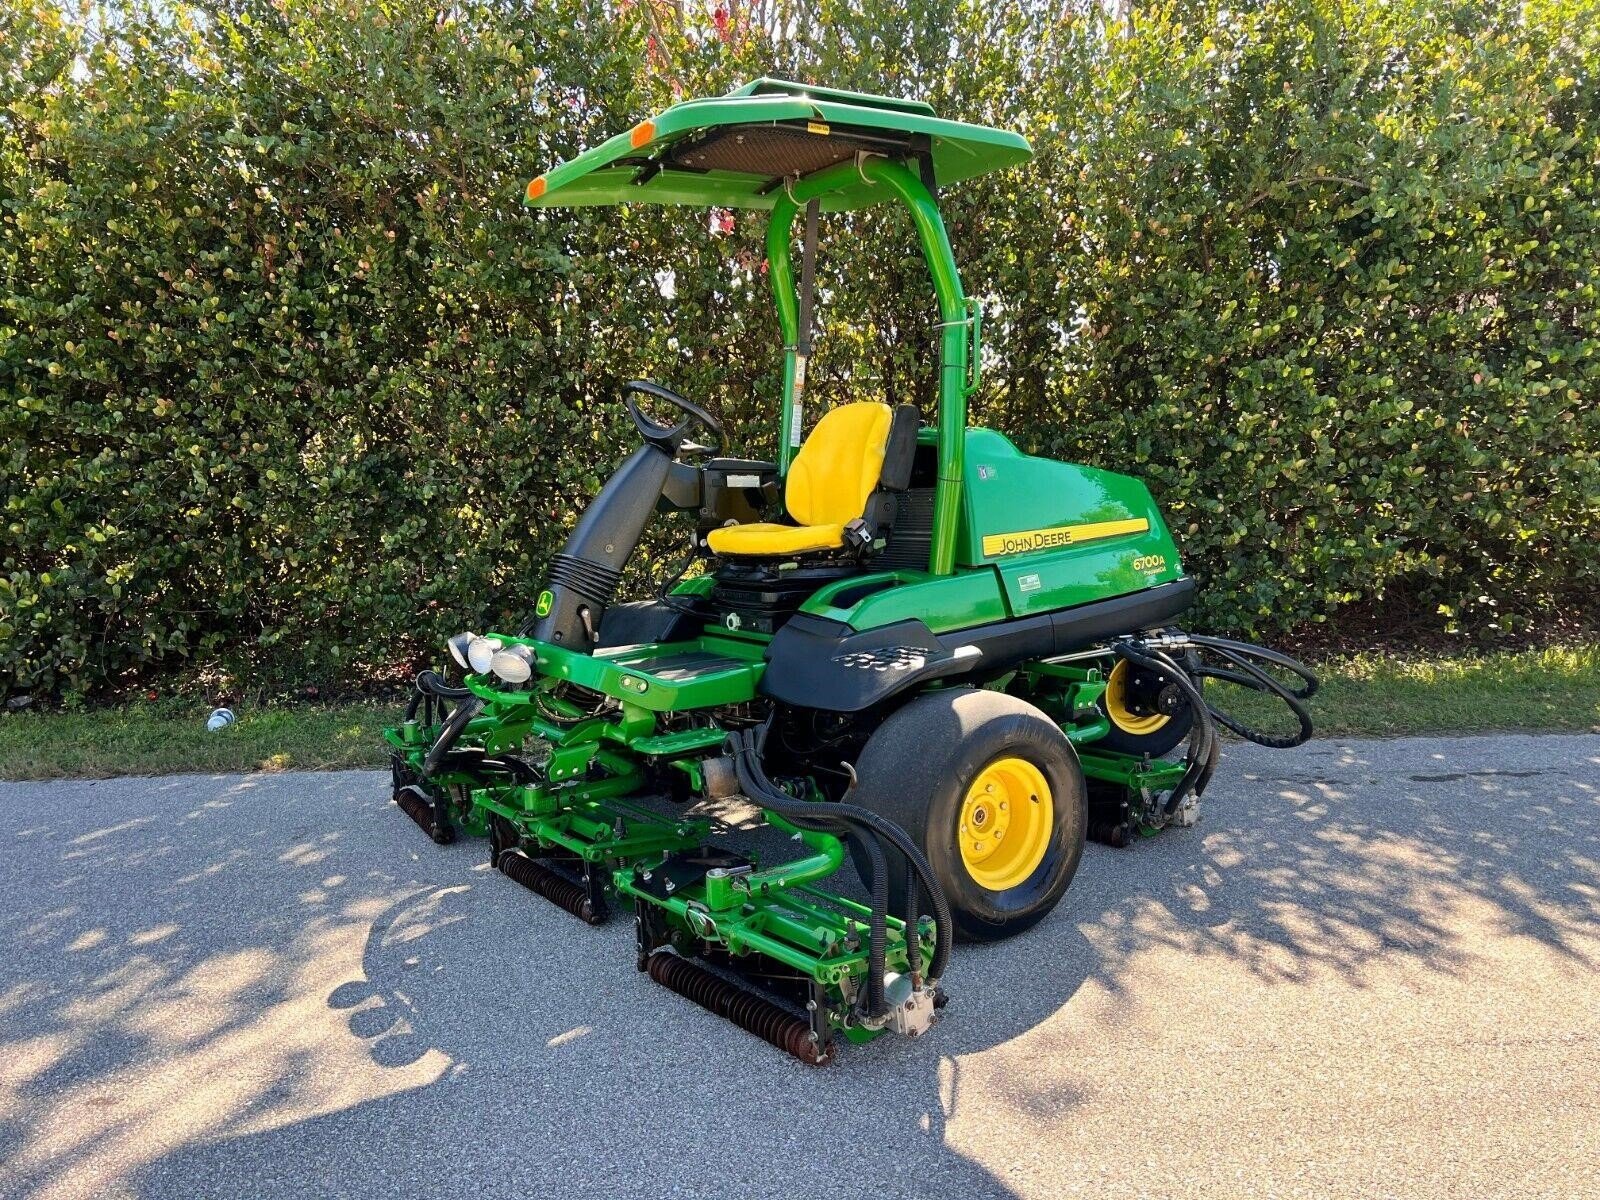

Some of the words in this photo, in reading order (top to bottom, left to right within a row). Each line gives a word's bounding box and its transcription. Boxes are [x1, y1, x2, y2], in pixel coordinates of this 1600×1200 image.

[1000, 536, 1032, 553] JOHN
[1034, 531, 1072, 548] DEERE
[1133, 554, 1165, 570] 6700A
